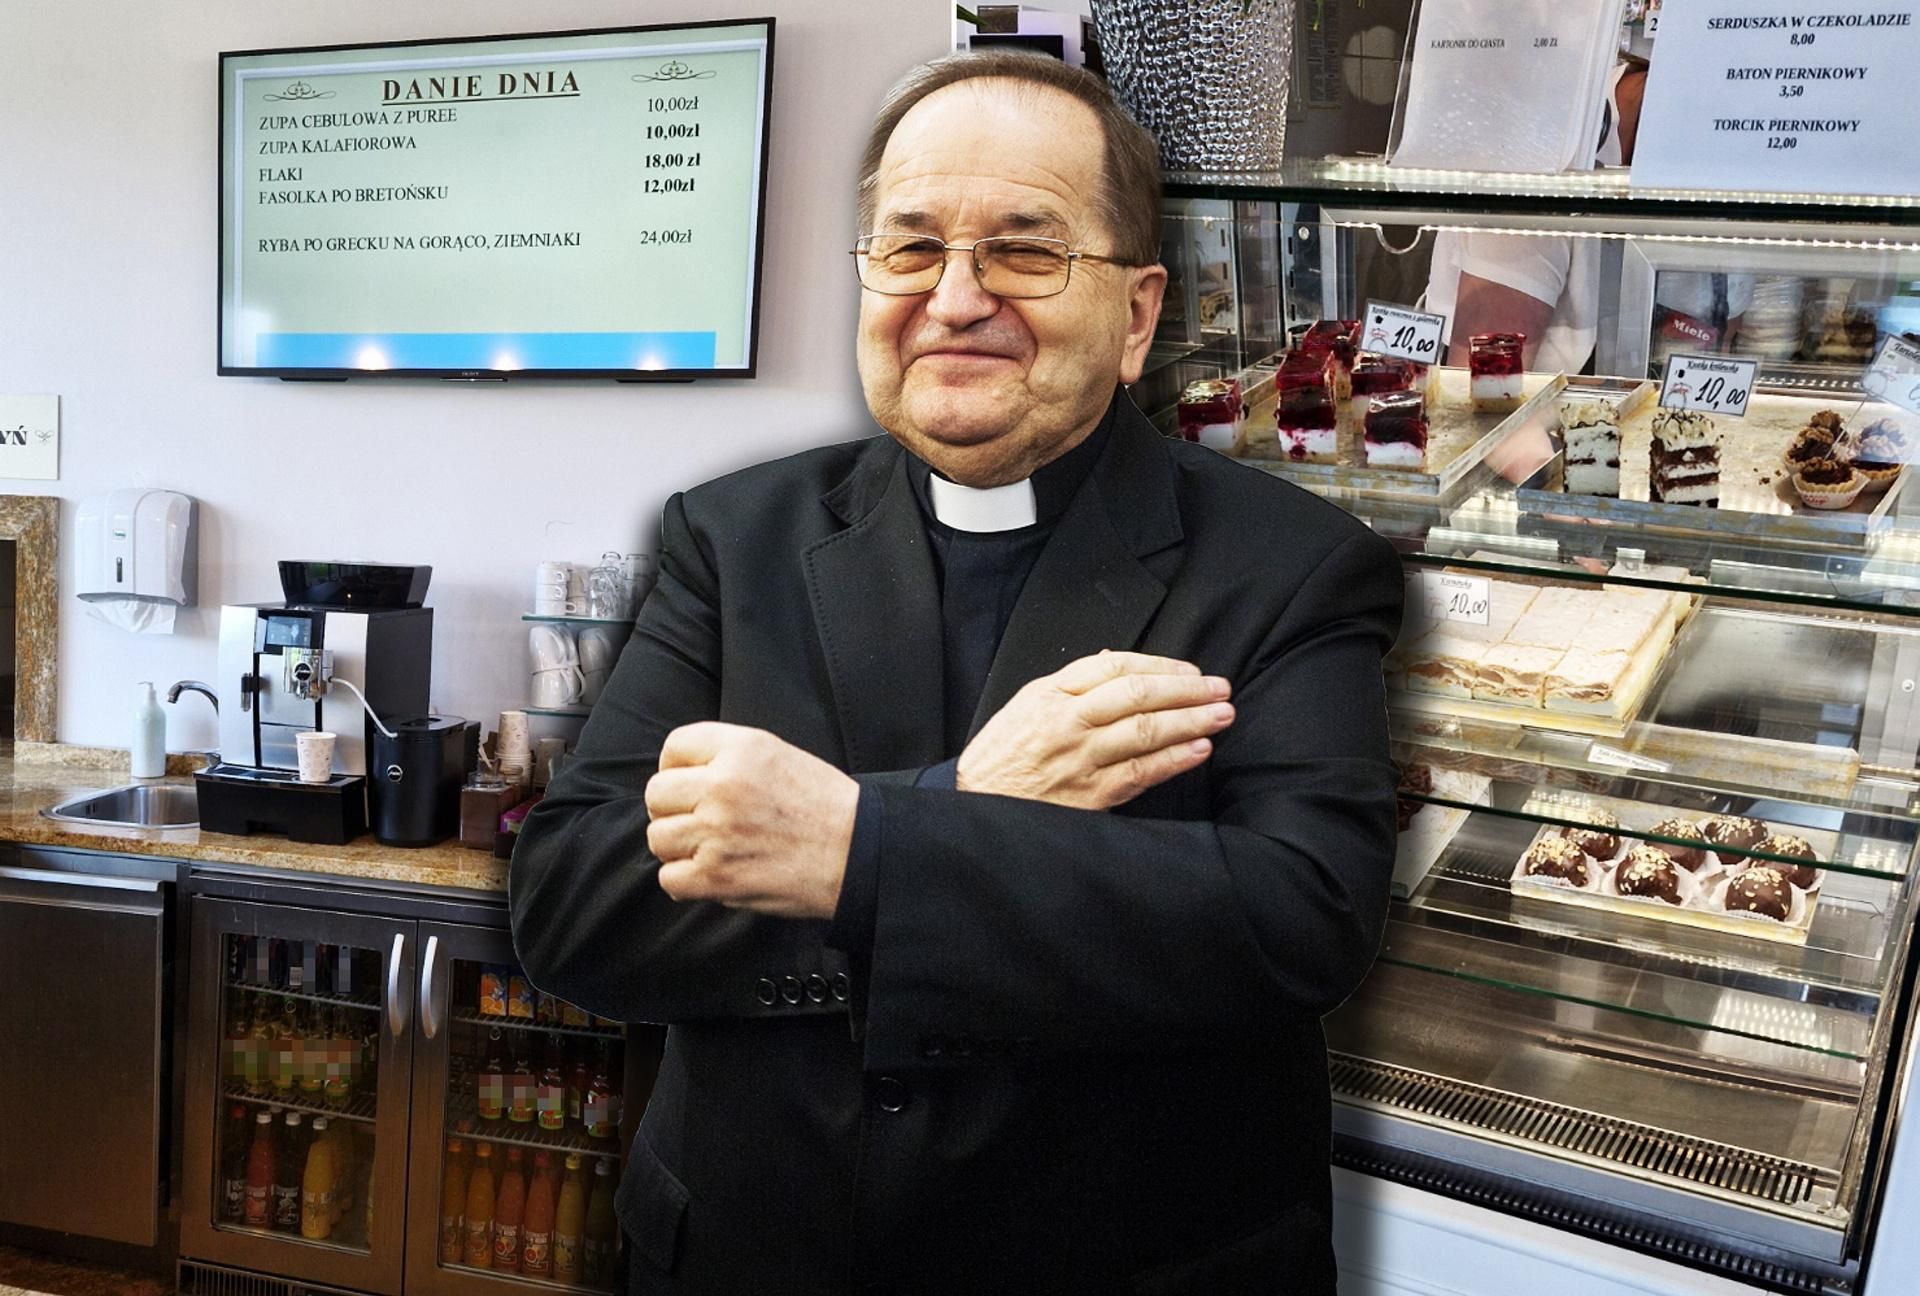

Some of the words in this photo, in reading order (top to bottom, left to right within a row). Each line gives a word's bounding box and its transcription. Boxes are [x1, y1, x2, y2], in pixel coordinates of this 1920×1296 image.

[1706, 16, 1786, 30] SERDUSZKA
[1790, 15, 1805, 29] W
[1806, 12, 1912, 28] CZEKOLADZIE
[1431, 39, 1467, 49] KARTONIK
[1467, 39, 1479, 49] DO
[1479, 38, 1506, 49] CIASTA
[1533, 37, 1548, 49] 2,00
[1790, 33, 1815, 46] 8,00
[1726, 68, 1773, 80] BATON
[1774, 67, 1868, 80] PIERNIKOWY
[382, 74, 483, 102] DANIE
[498, 70, 581, 96] DNIA
[1779, 85, 1804, 99] 3,50
[648, 96, 699, 113] 10,00zł
[259, 115, 299, 130] ZUPA
[302, 111, 390, 129] CEBULOWA
[393, 110, 404, 125] Z
[406, 107, 458, 124] PUREE
[1713, 118, 1765, 132] TORCIK
[1768, 119, 1861, 133] PIERNIKOWY
[259, 140, 299, 155] ZUPA
[301, 136, 417, 154] KALAFIOROWA
[1766, 136, 1798, 150] 12,00
[645, 153, 684, 170] 18,00
[259, 167, 303, 182] FLAKI
[259, 189, 327, 205] FASOLKA
[332, 188, 352, 203] PO
[355, 184, 449, 202] BRETOŃSKU
[259, 238, 300, 253] RYBA
[303, 238, 323, 252] PO
[326, 236, 390, 251] GRECKU
[393, 236, 416, 250] NA
[419, 234, 491, 252] GORĄCO,
[493, 232, 582, 249] ZIEMNIAKI
[640, 229, 693, 246] 24,00zł
[1672, 319, 1711, 341] Miele
[1391, 325, 1435, 354] 10,00
[1695, 376, 1746, 410] 10,00
[1449, 592, 1487, 618] 10,00
